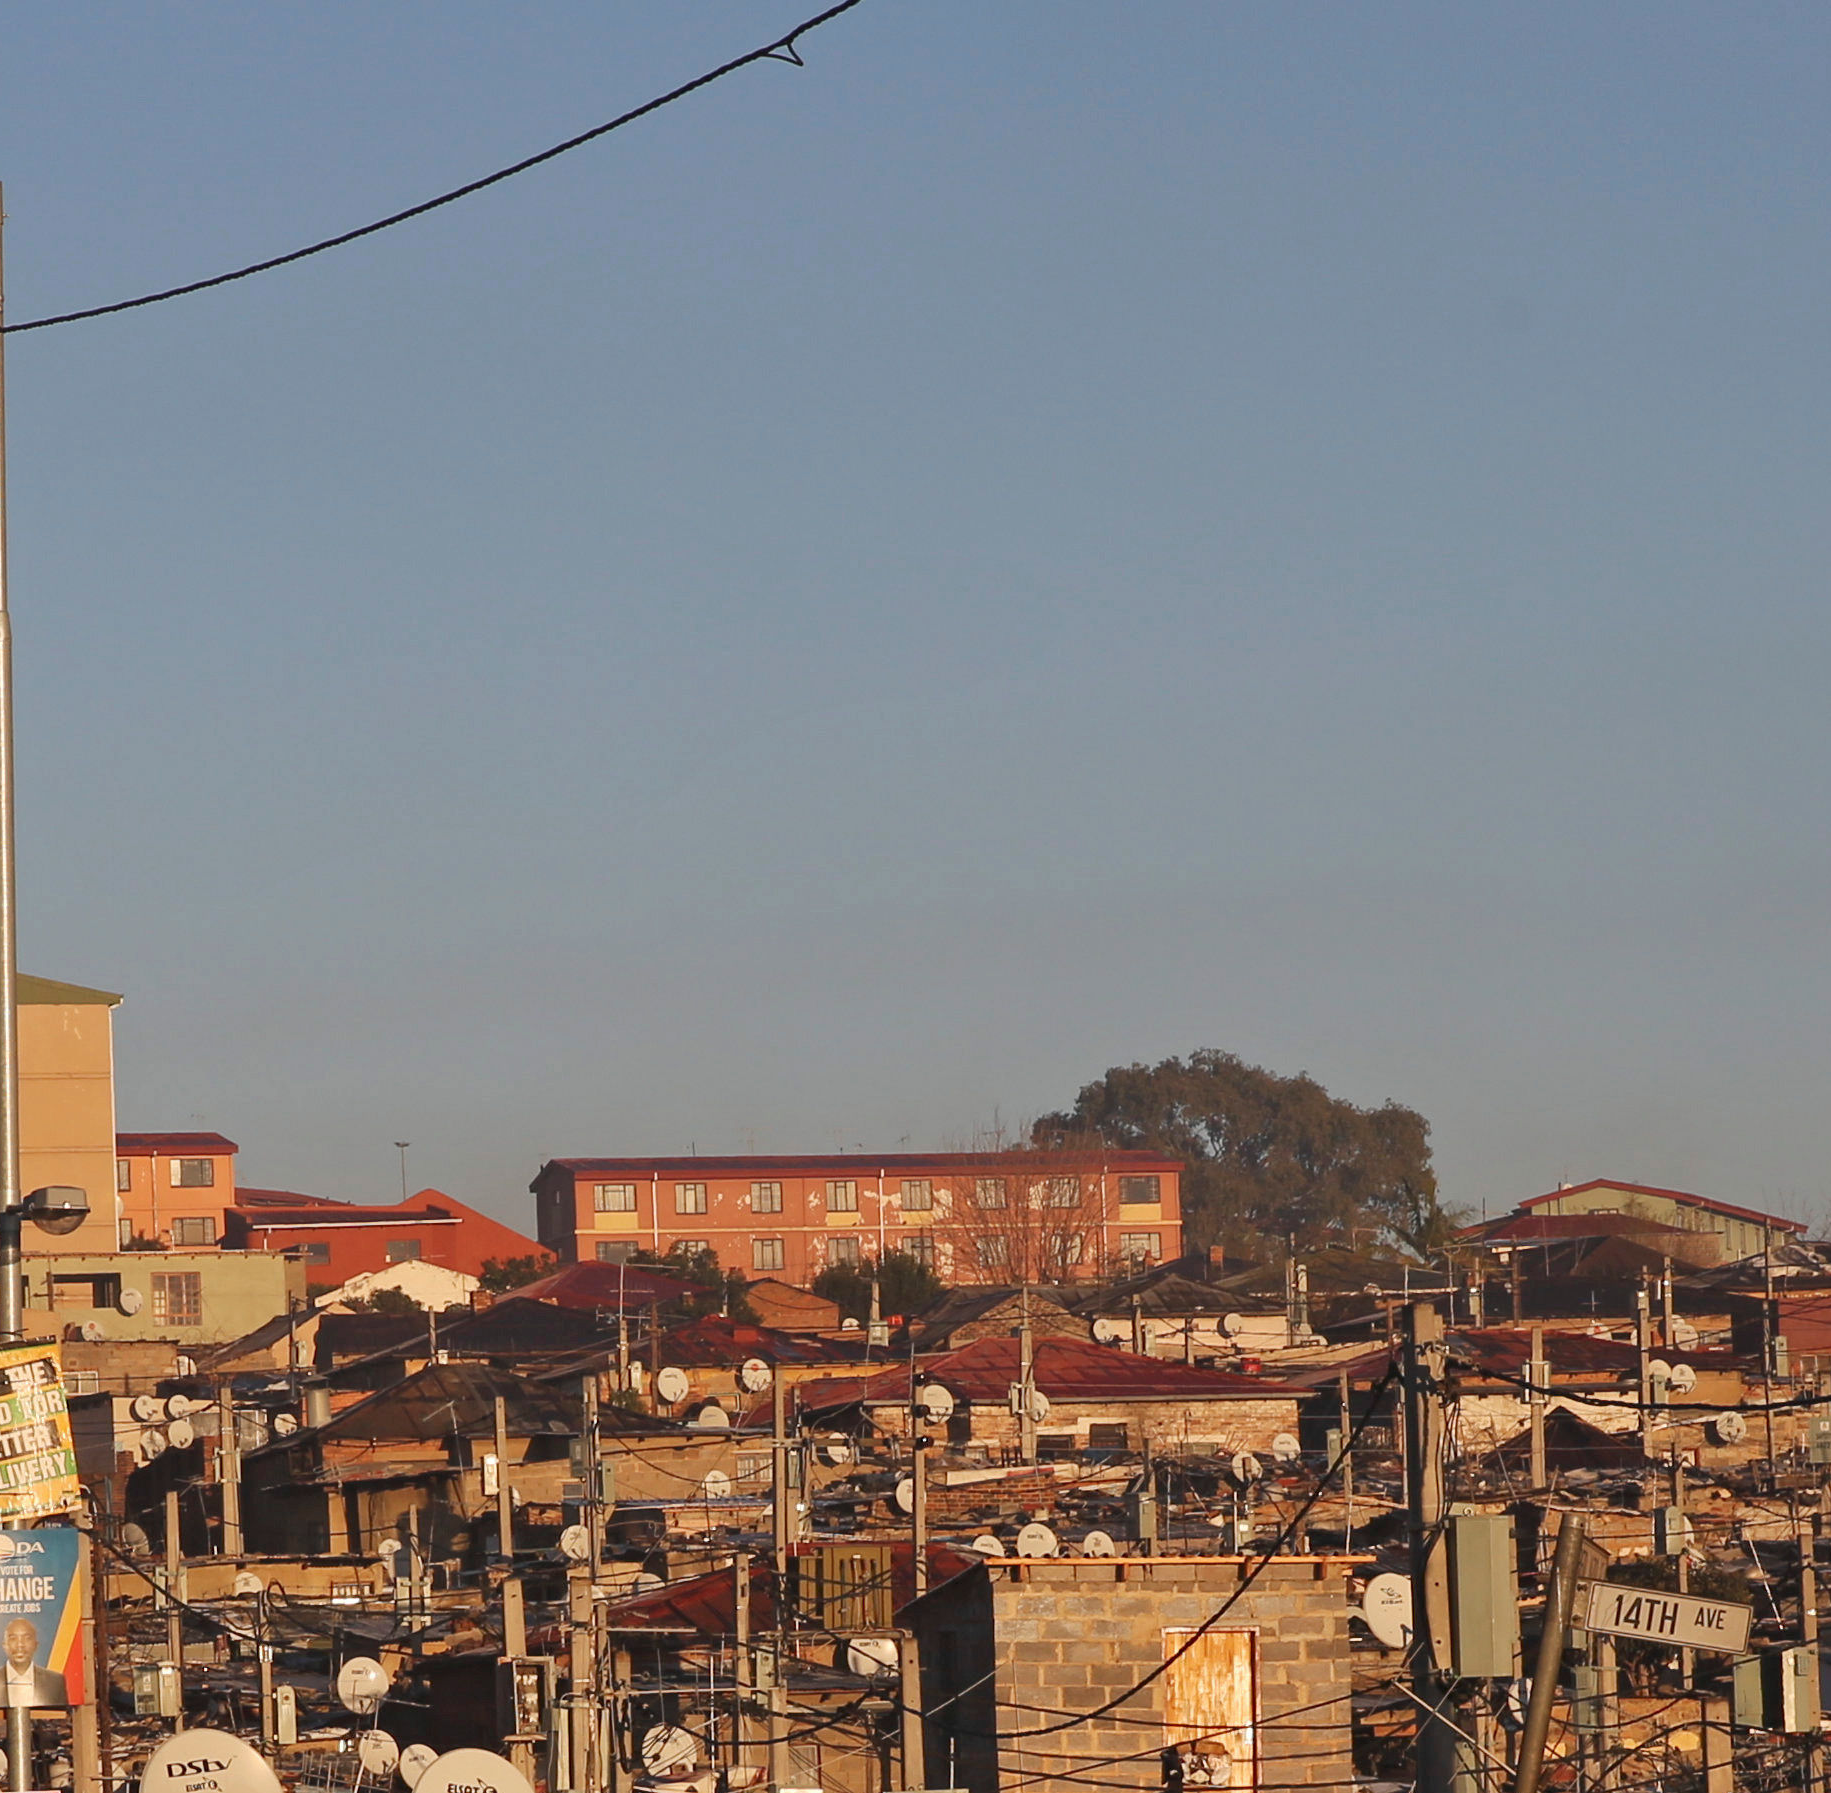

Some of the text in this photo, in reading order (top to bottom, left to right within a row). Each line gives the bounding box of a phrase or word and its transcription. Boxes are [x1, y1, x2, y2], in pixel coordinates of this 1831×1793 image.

[4, 1361, 48, 1386] THE
[18, 1389, 64, 1420] FOR
[16, 1541, 46, 1554] DA
[0, 1564, 34, 1576] VOTE FOR
[1614, 1594, 1727, 1635] 14TH AVE
